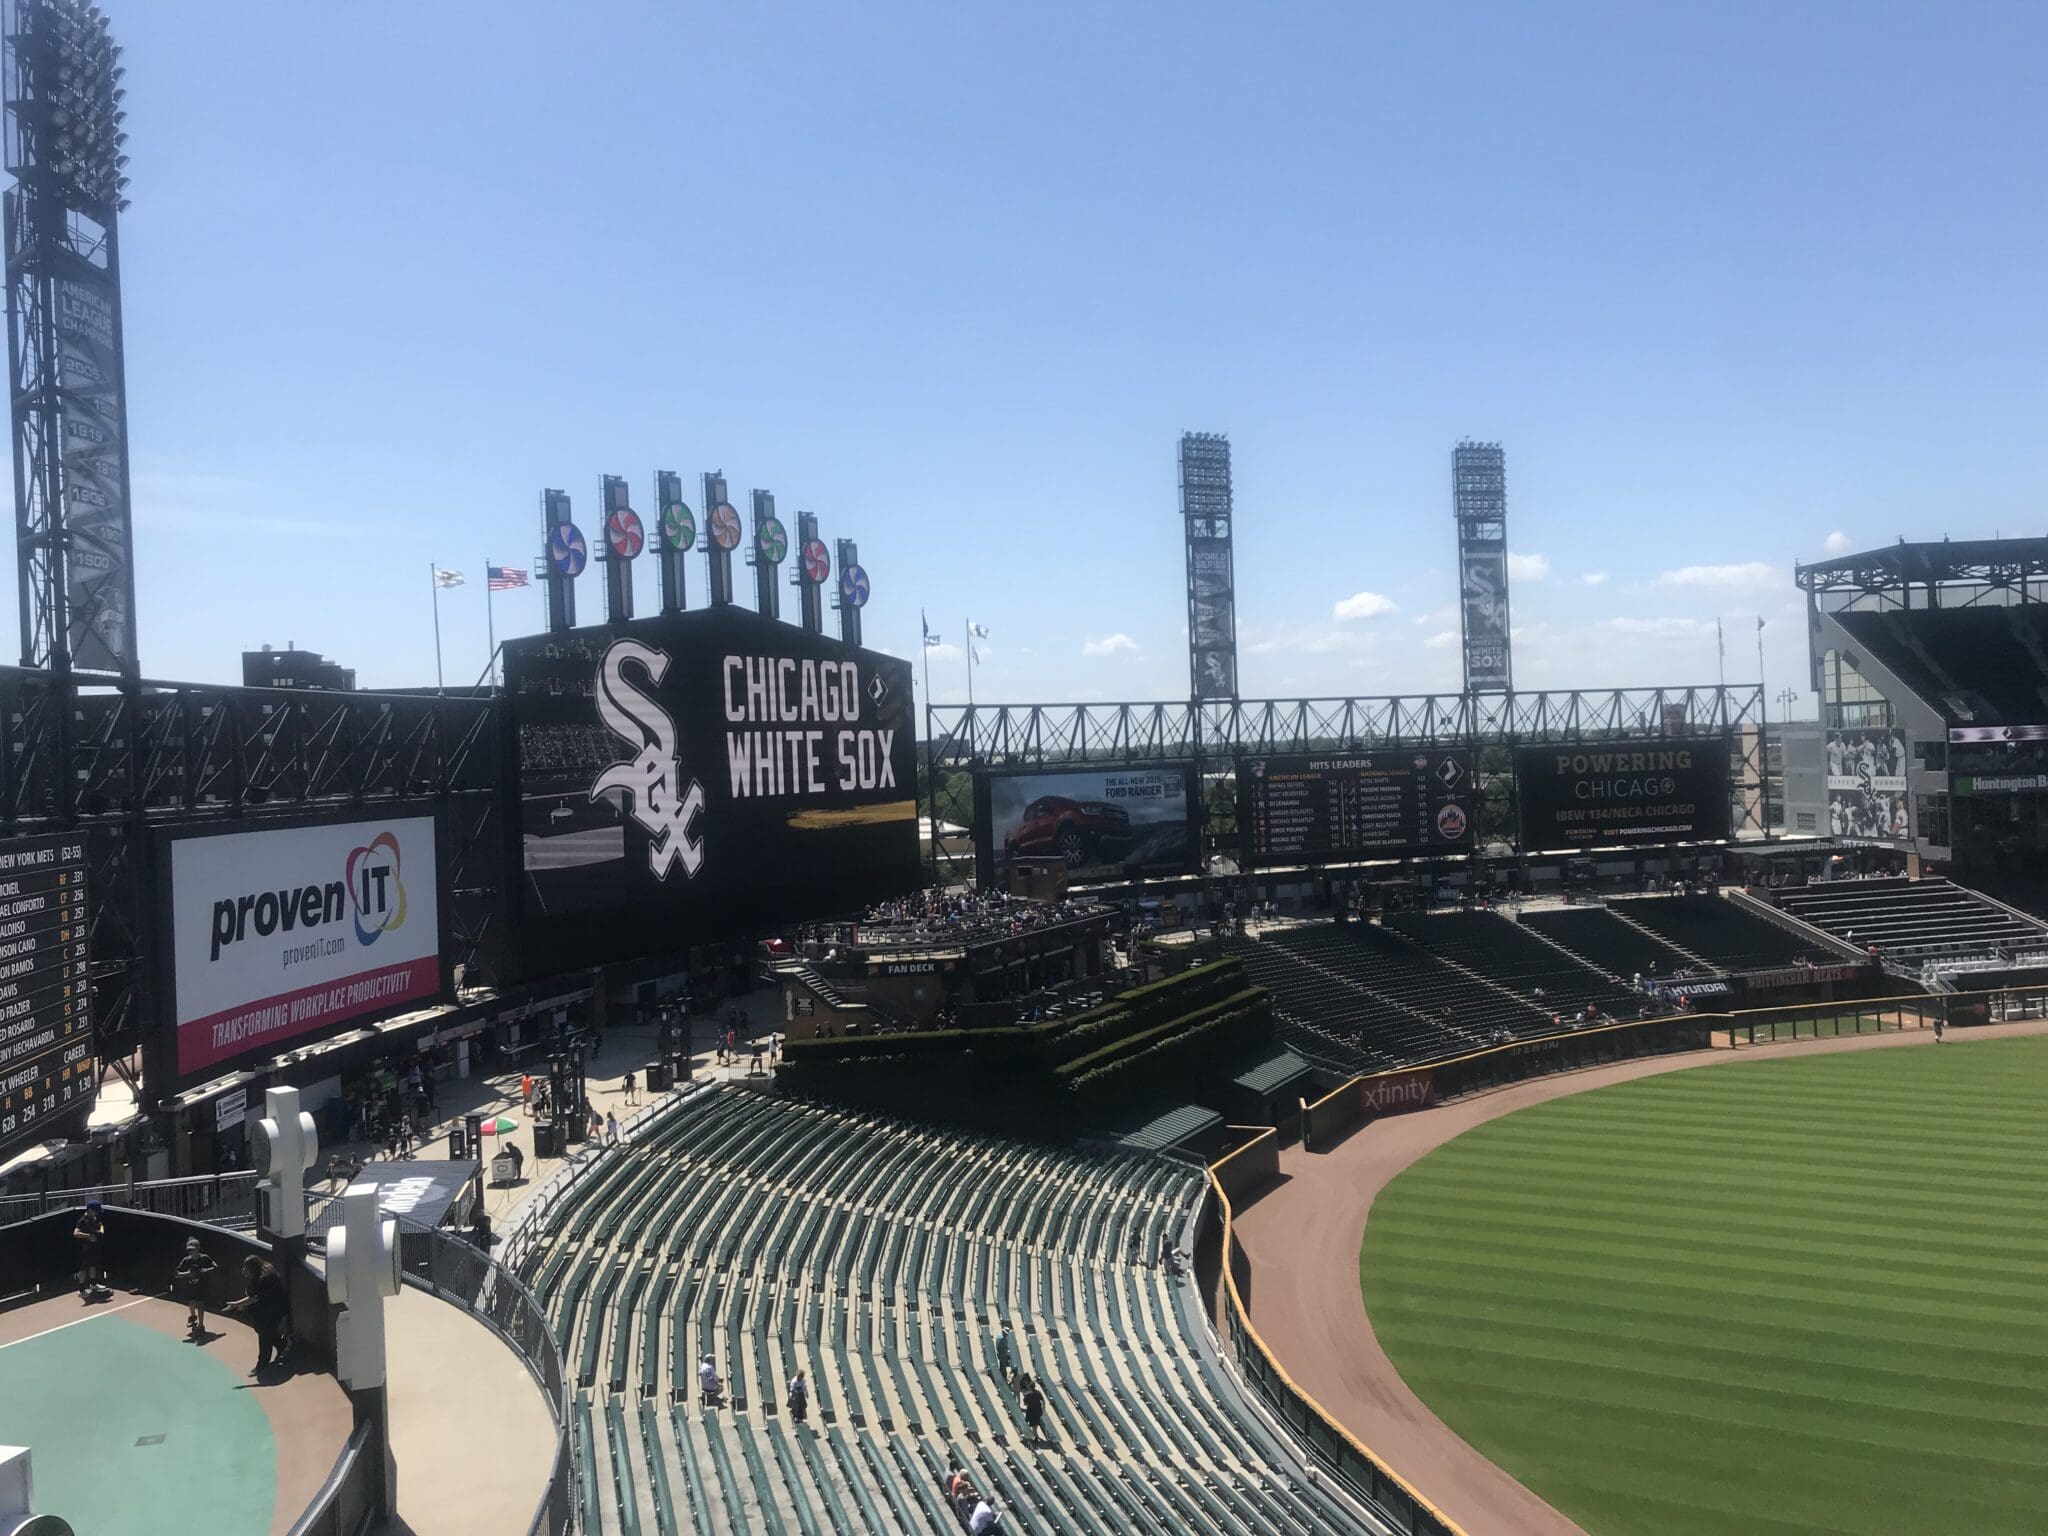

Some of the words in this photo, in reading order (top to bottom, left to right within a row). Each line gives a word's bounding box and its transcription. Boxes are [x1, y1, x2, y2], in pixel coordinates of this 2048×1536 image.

[62, 280, 111, 316] AMERICAN
[63, 296, 112, 335] LEAGUE
[65, 358, 99, 380] 2005
[1471, 647, 1502, 655] WHITE
[1472, 655, 1502, 668] SOX
[723, 655, 860, 722] CHICAGO
[726, 730, 825, 798] WHITE
[837, 729, 896, 791] SOX
[1310, 761, 1330, 770] HITS
[1332, 760, 1372, 769] LEADERS
[1556, 750, 1692, 775] POWERING
[1106, 787, 1126, 798] FORD
[1129, 785, 1161, 797] RANGER
[1972, 776, 2036, 792] Huntington
[1645, 803, 1696, 817] CHICAGO
[0, 854, 15, 869] NEW
[17, 851, 36, 867] YORK
[36, 849, 54, 863] METS
[62, 845, 82, 861] (52-55)
[12, 897, 45, 915] CONFORTO
[210, 880, 345, 962] proven
[362, 865, 390, 915] IT
[0, 920, 26, 938] ALONSO
[18, 938, 36, 953] CANO
[283, 937, 345, 970] provenIT.com
[11, 958, 34, 976] RAMOS
[888, 965, 908, 974] FAN
[909, 963, 935, 973] DECK
[1672, 982, 1728, 997] HYUNDAI
[1748, 970, 1811, 990] WHITTINGHAM
[1813, 968, 1842, 983] MEATS
[6, 1000, 31, 1019] FRAZIER
[212, 1004, 288, 1049] TRANSFORMING
[290, 991, 345, 1022] WORKPLACE
[347, 970, 412, 1008] PRODUCTIVITY
[8, 1017, 35, 1039] ROSARIO
[13, 1030, 55, 1057] HECHAVARRIA
[8, 1065, 39, 1090] WHEELER
[64, 1044, 86, 1064] CAREER
[2, 1114, 16, 1133] 628
[22, 1103, 36, 1123] 254
[42, 1094, 55, 1112] 318
[63, 1085, 72, 1101] 70
[79, 1075, 91, 1092] 1.30
[5, 1096, 11, 1109] H
[24, 1086, 33, 1100] BB
[1364, 1077, 1431, 1111] xfinity
